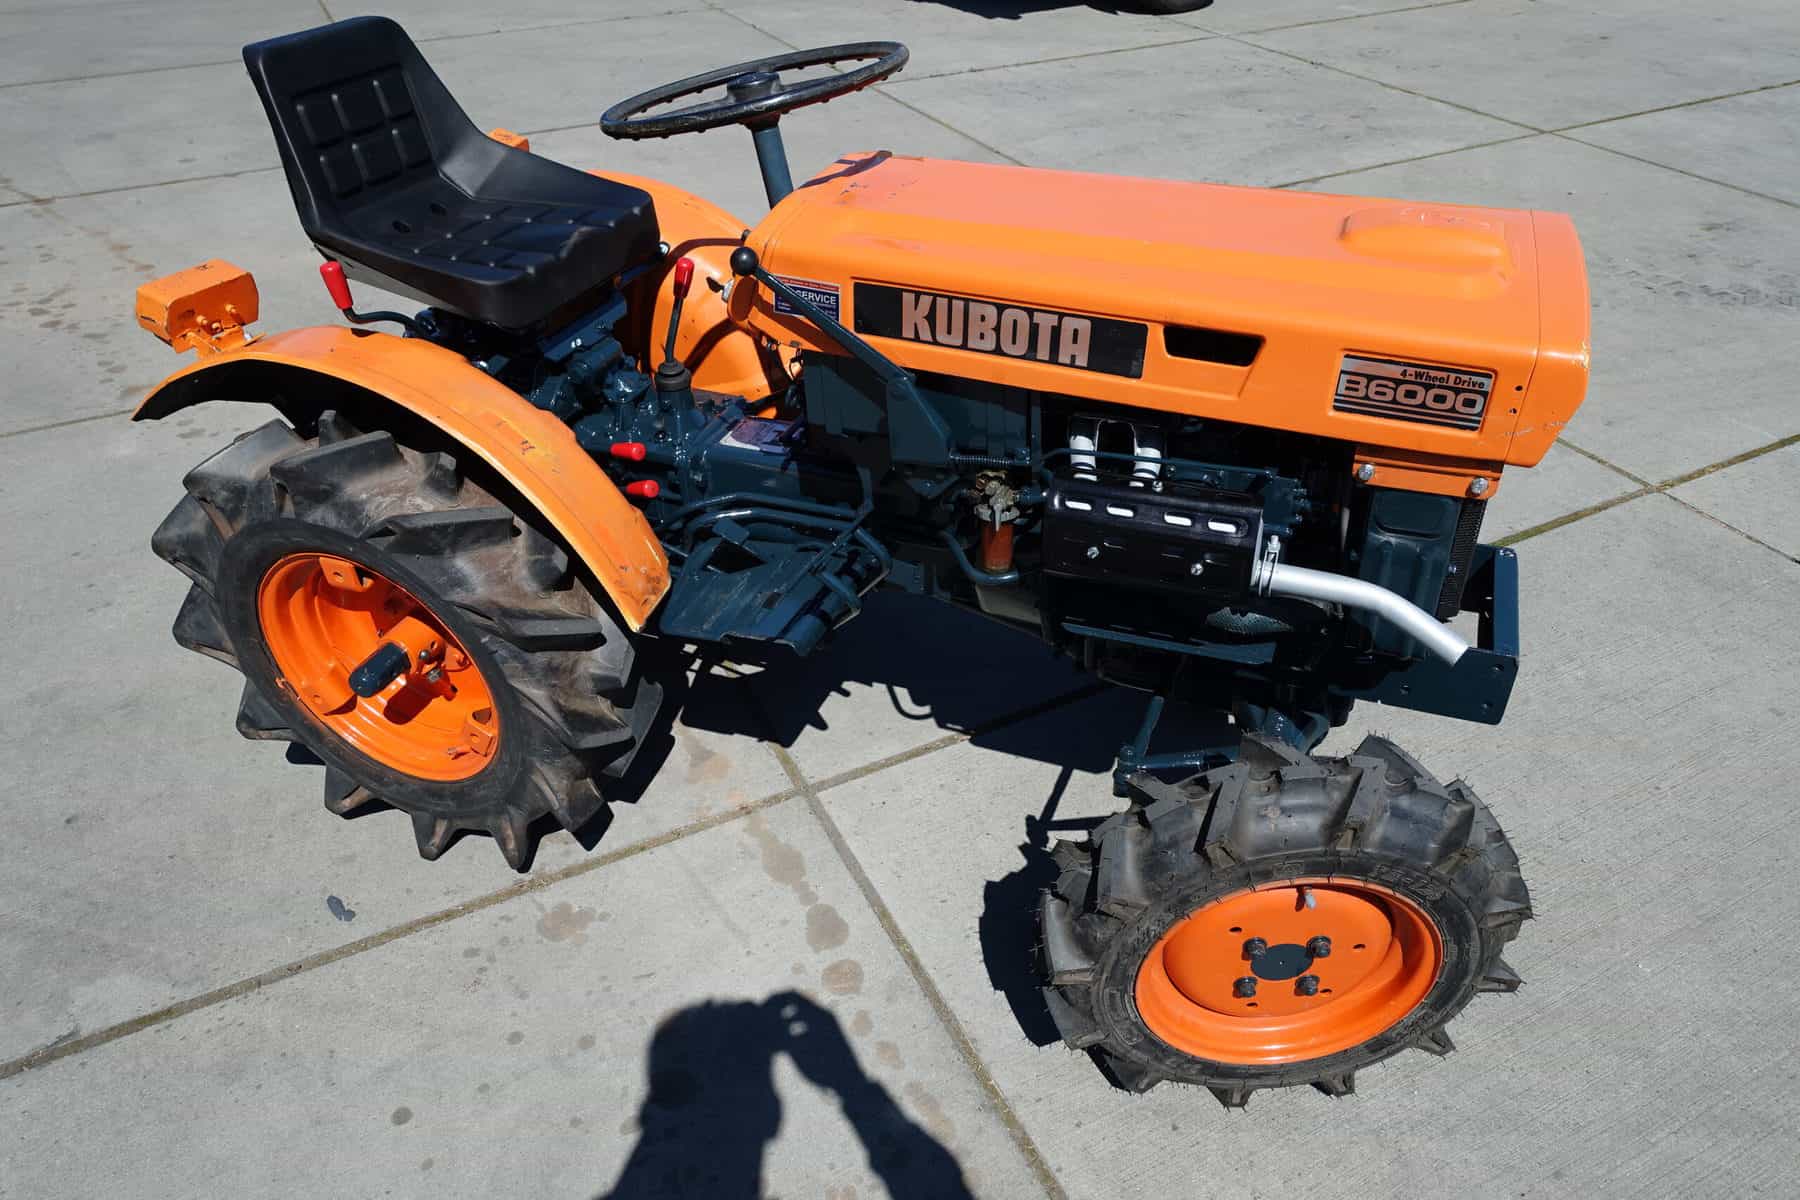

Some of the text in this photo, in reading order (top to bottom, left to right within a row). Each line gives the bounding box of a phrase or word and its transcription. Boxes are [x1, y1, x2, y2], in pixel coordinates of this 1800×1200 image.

[902, 291, 1092, 367] KUBOTA
[1336, 372, 1485, 415] B6000
[1400, 368, 1485, 390] 4-Wheel Drive
